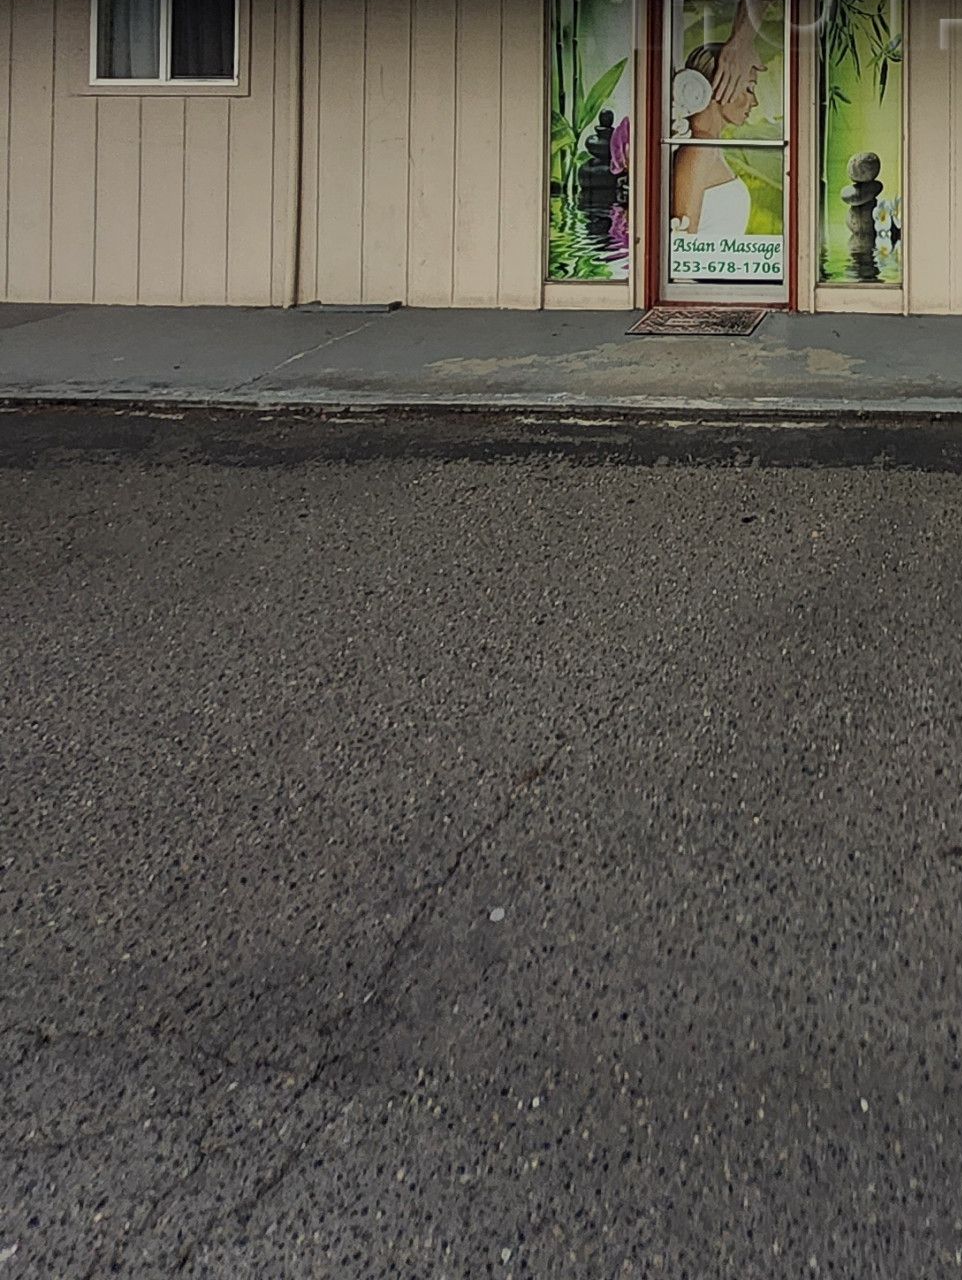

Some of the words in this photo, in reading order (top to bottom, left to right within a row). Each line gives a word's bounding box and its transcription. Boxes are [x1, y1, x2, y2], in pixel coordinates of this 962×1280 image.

[673, 238, 716, 253] Asian
[719, 238, 781, 260] Massage
[672, 260, 781, 273] 253-678-1706
